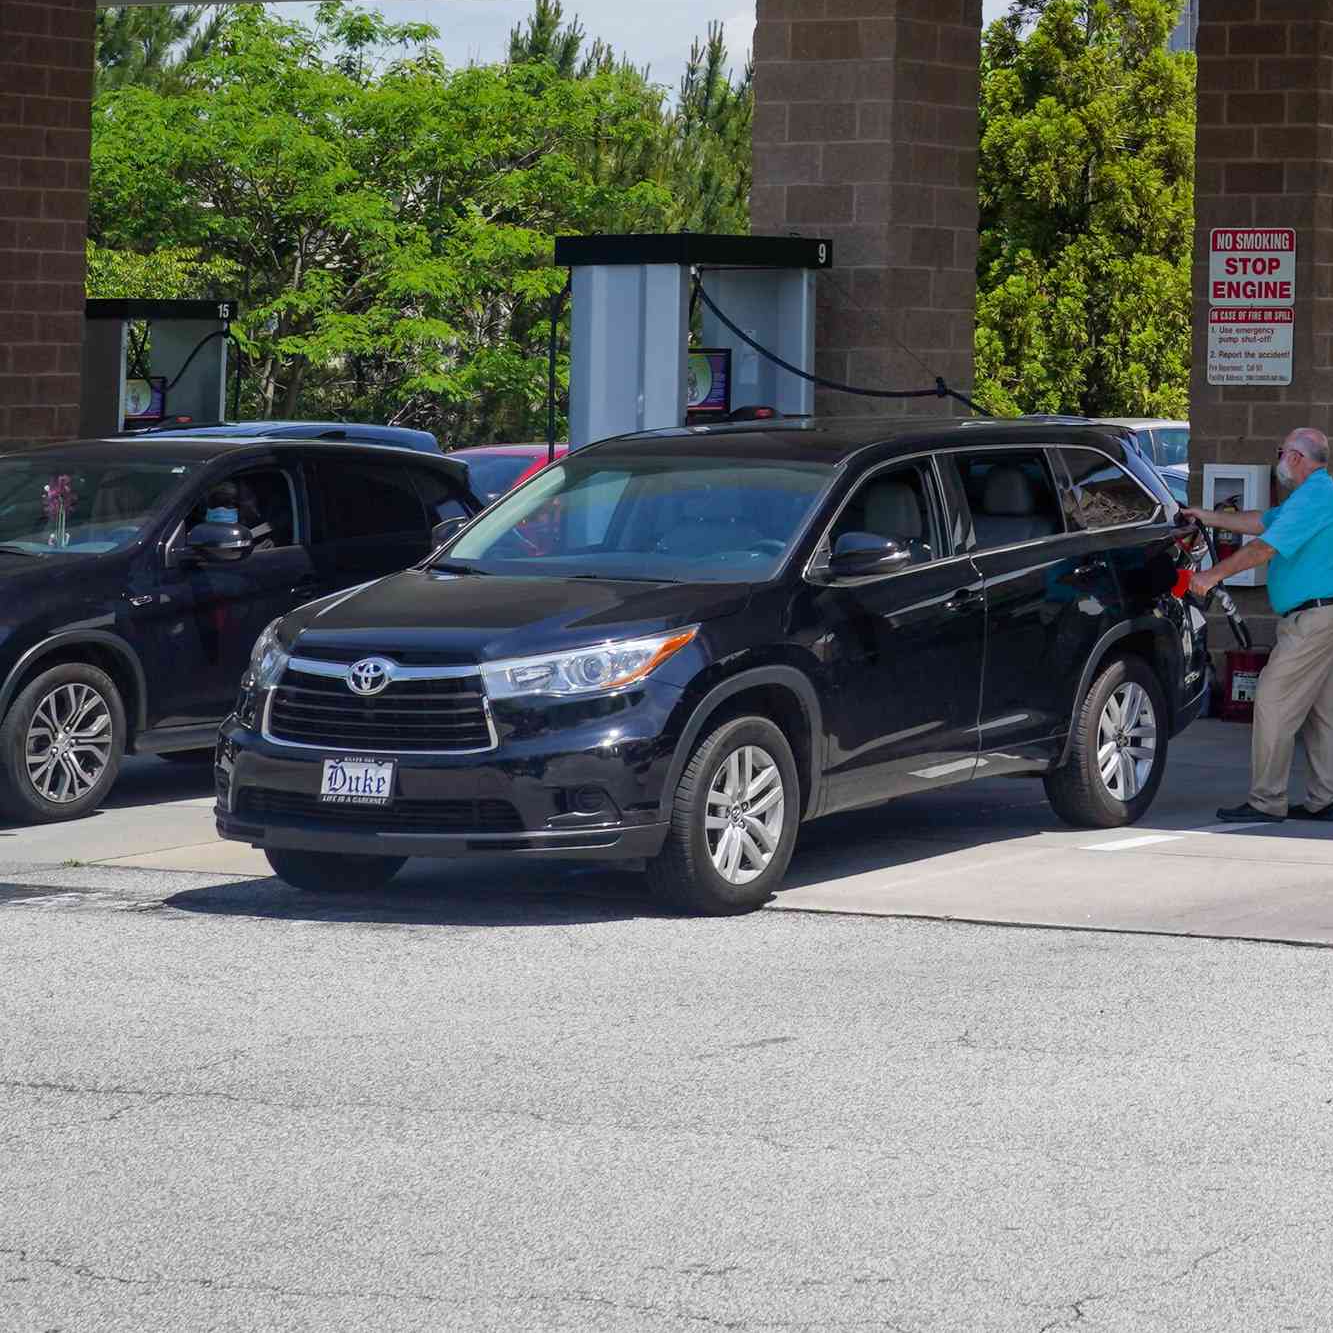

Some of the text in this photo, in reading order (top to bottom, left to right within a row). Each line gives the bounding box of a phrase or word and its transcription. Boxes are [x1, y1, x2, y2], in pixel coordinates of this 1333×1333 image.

[1216, 232, 1290, 250] NO SMOKING
[818, 243, 826, 264] 9
[1224, 257, 1281, 276] STOP
[1212, 280, 1292, 299] ENGINE
[217, 304, 229, 318] 15
[1236, 328, 1274, 336] emergency
[1218, 351, 1243, 360] Report
[1244, 351, 1256, 359] the
[328, 764, 386, 795] Duke
